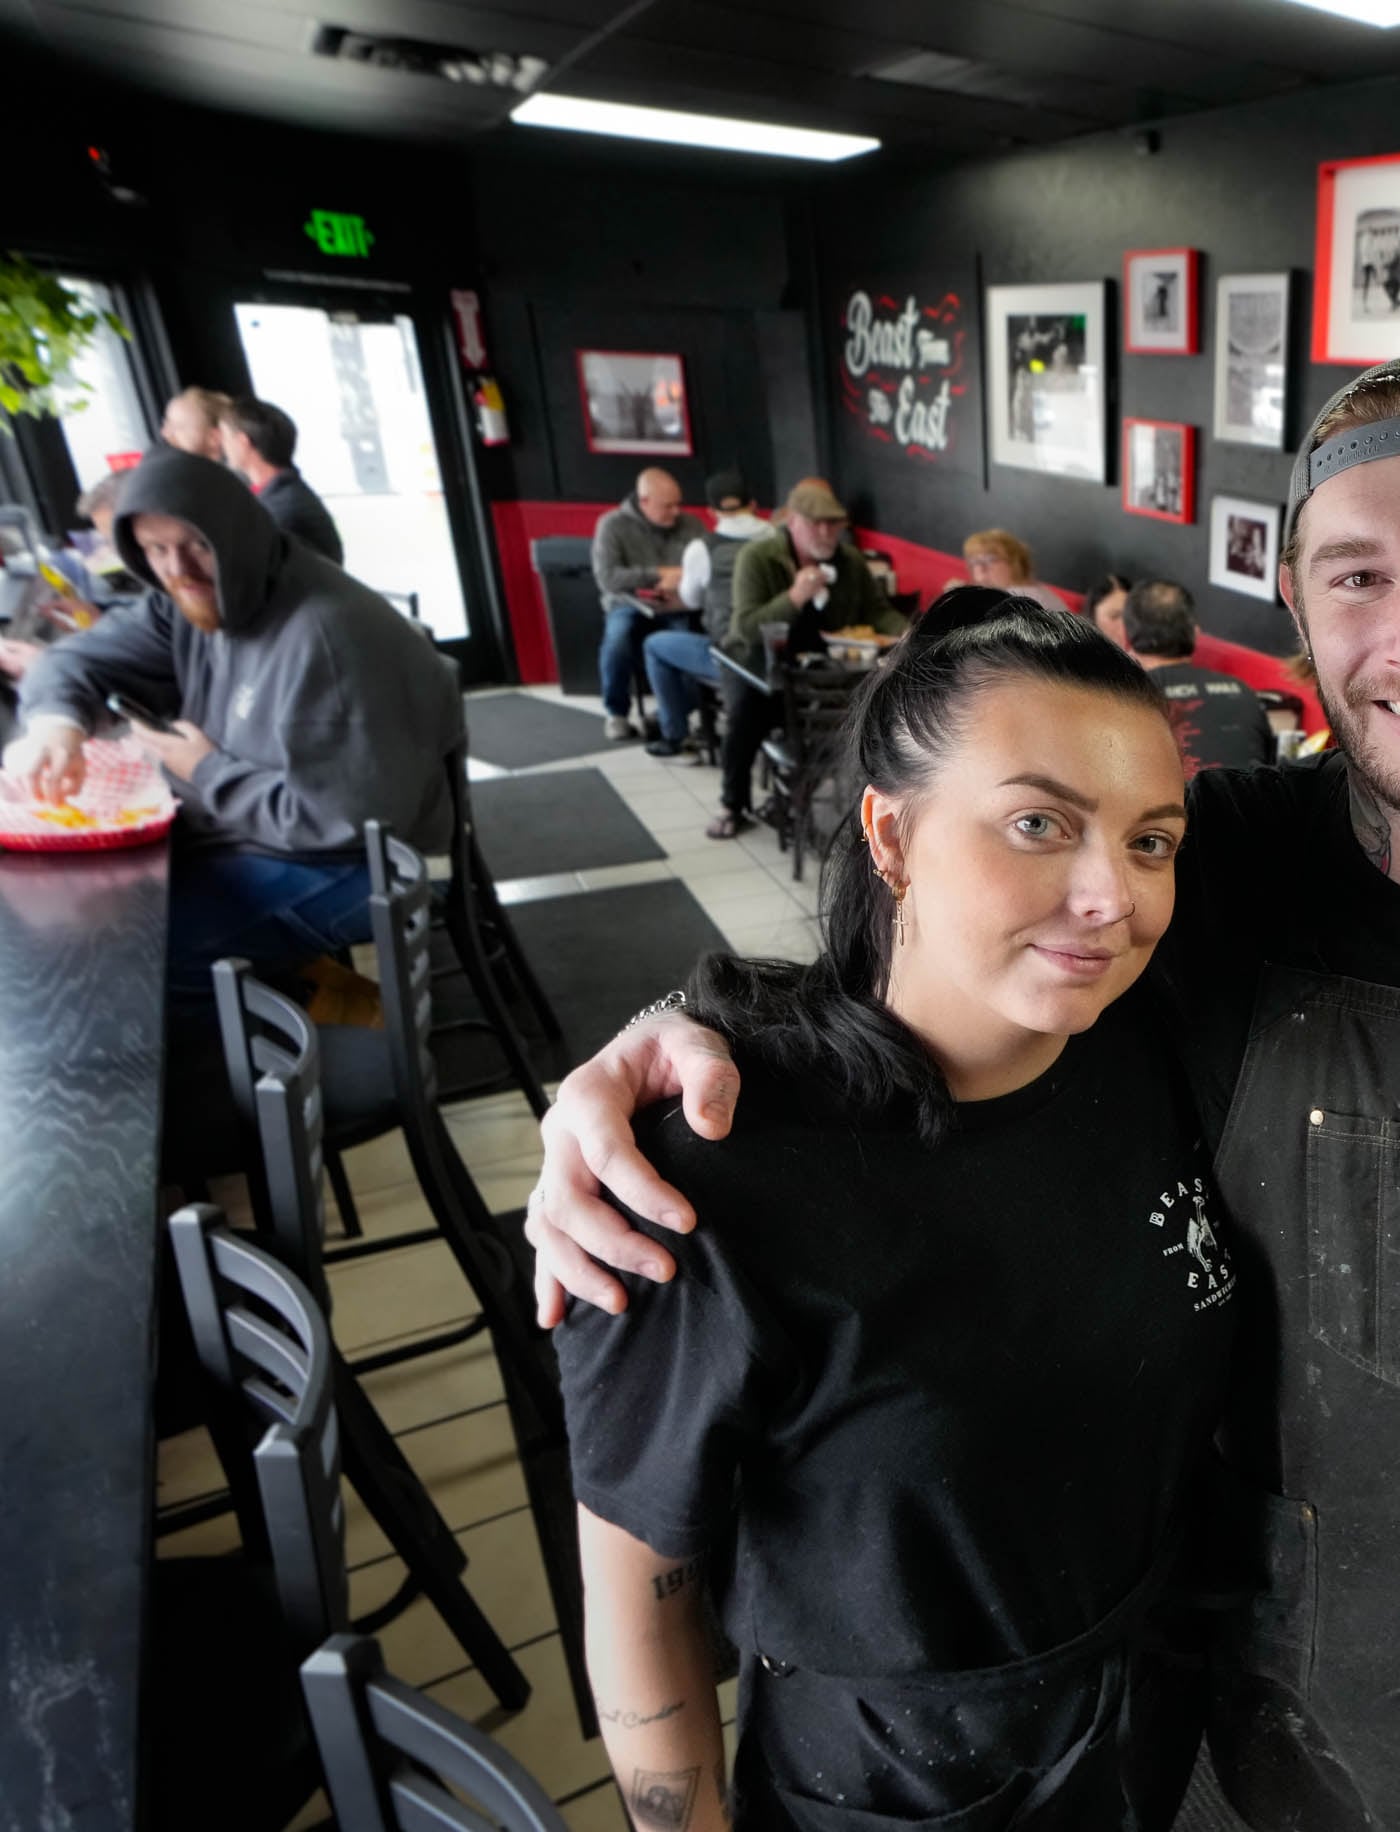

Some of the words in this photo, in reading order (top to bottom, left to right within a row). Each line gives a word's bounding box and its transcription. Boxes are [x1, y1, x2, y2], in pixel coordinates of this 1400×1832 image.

[311, 208, 369, 258] EXIT
[845, 290, 919, 377] Beast
[895, 375, 951, 450] East
[1149, 1177, 1204, 1227] BEAS
[1162, 1242, 1184, 1257] FROM
